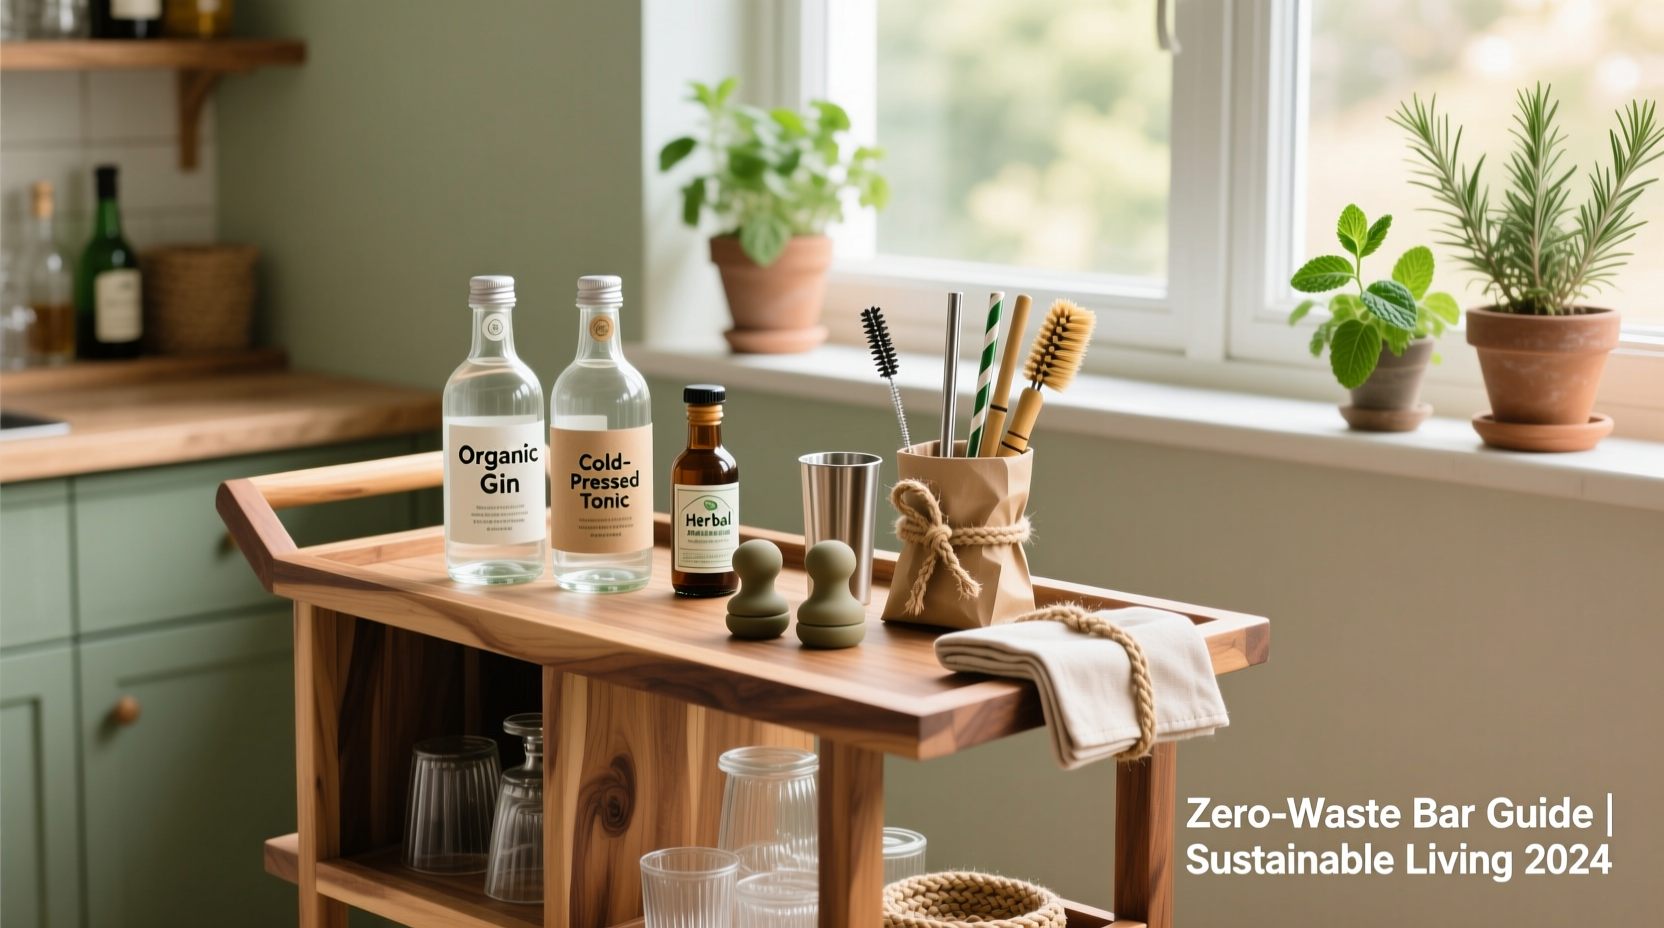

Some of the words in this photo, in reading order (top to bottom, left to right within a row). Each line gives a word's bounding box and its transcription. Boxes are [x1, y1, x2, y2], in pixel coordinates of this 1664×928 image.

[458, 443, 539, 470] Organic
[579, 453, 631, 471] Cold-
[480, 473, 520, 494] Gin
[570, 470, 640, 490] Pressed
[580, 492, 630, 509] Tonic
[685, 511, 732, 527] Herbal
